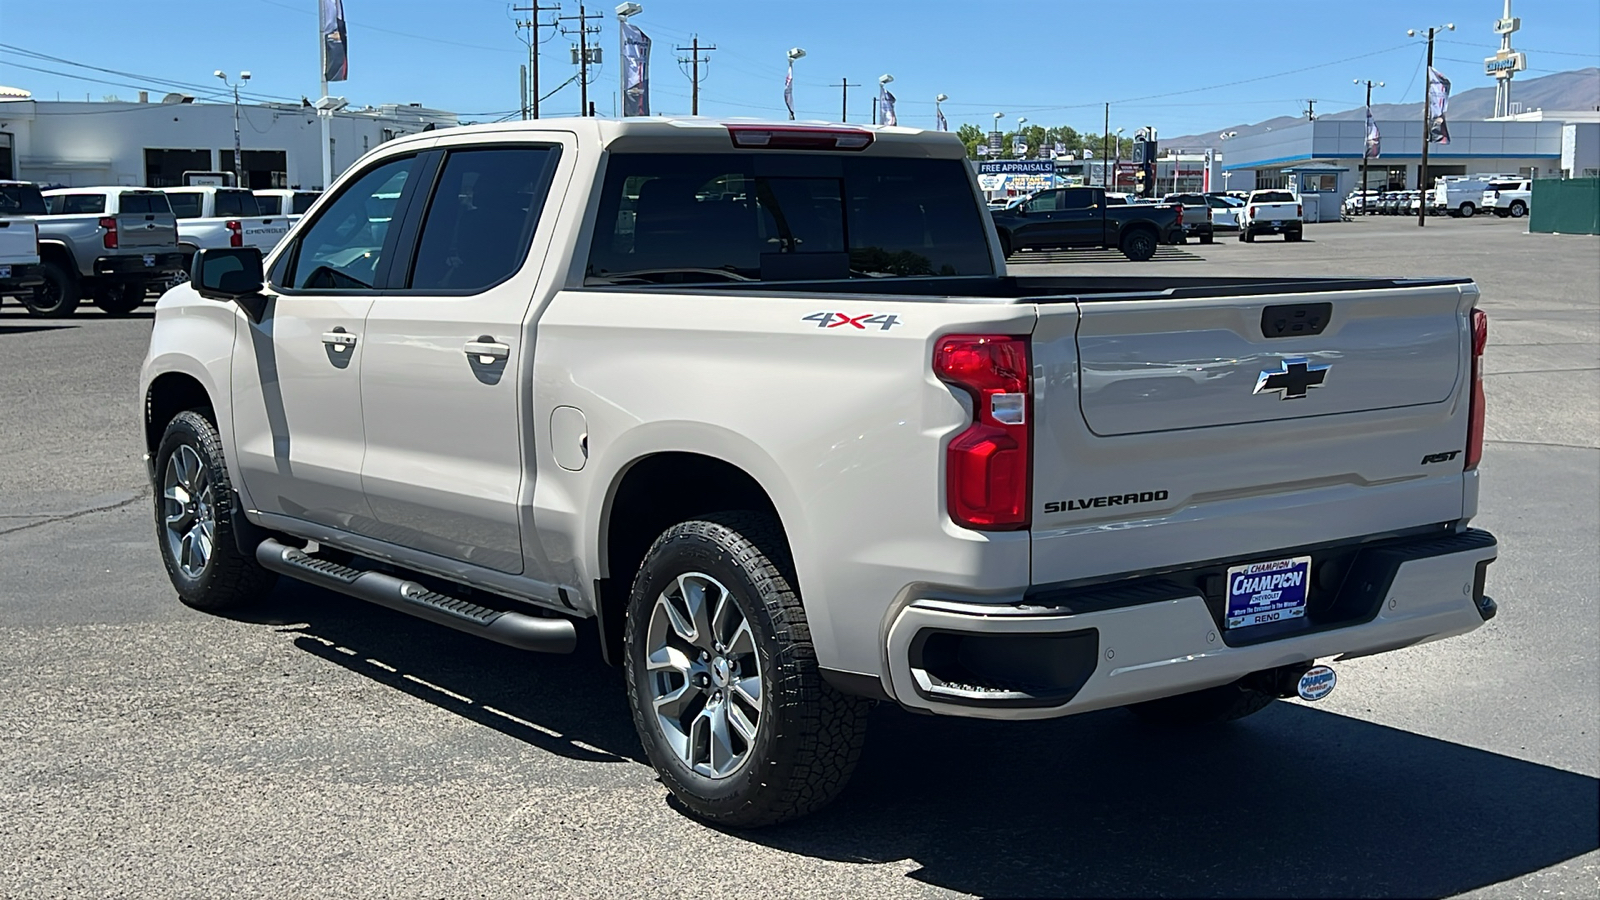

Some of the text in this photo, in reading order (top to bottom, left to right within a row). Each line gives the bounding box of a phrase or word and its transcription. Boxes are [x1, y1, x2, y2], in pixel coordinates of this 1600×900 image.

[981, 163, 1053, 172] FREE APPRAISALS!
[1421, 450, 1462, 465] RST
[1044, 490, 1168, 513] SILVERADO
[1250, 561, 1290, 573] CHAMPION
[1232, 571, 1303, 596] CHAMPION
[1252, 592, 1280, 602] CHEVROLET
[1254, 612, 1280, 623] RENO
